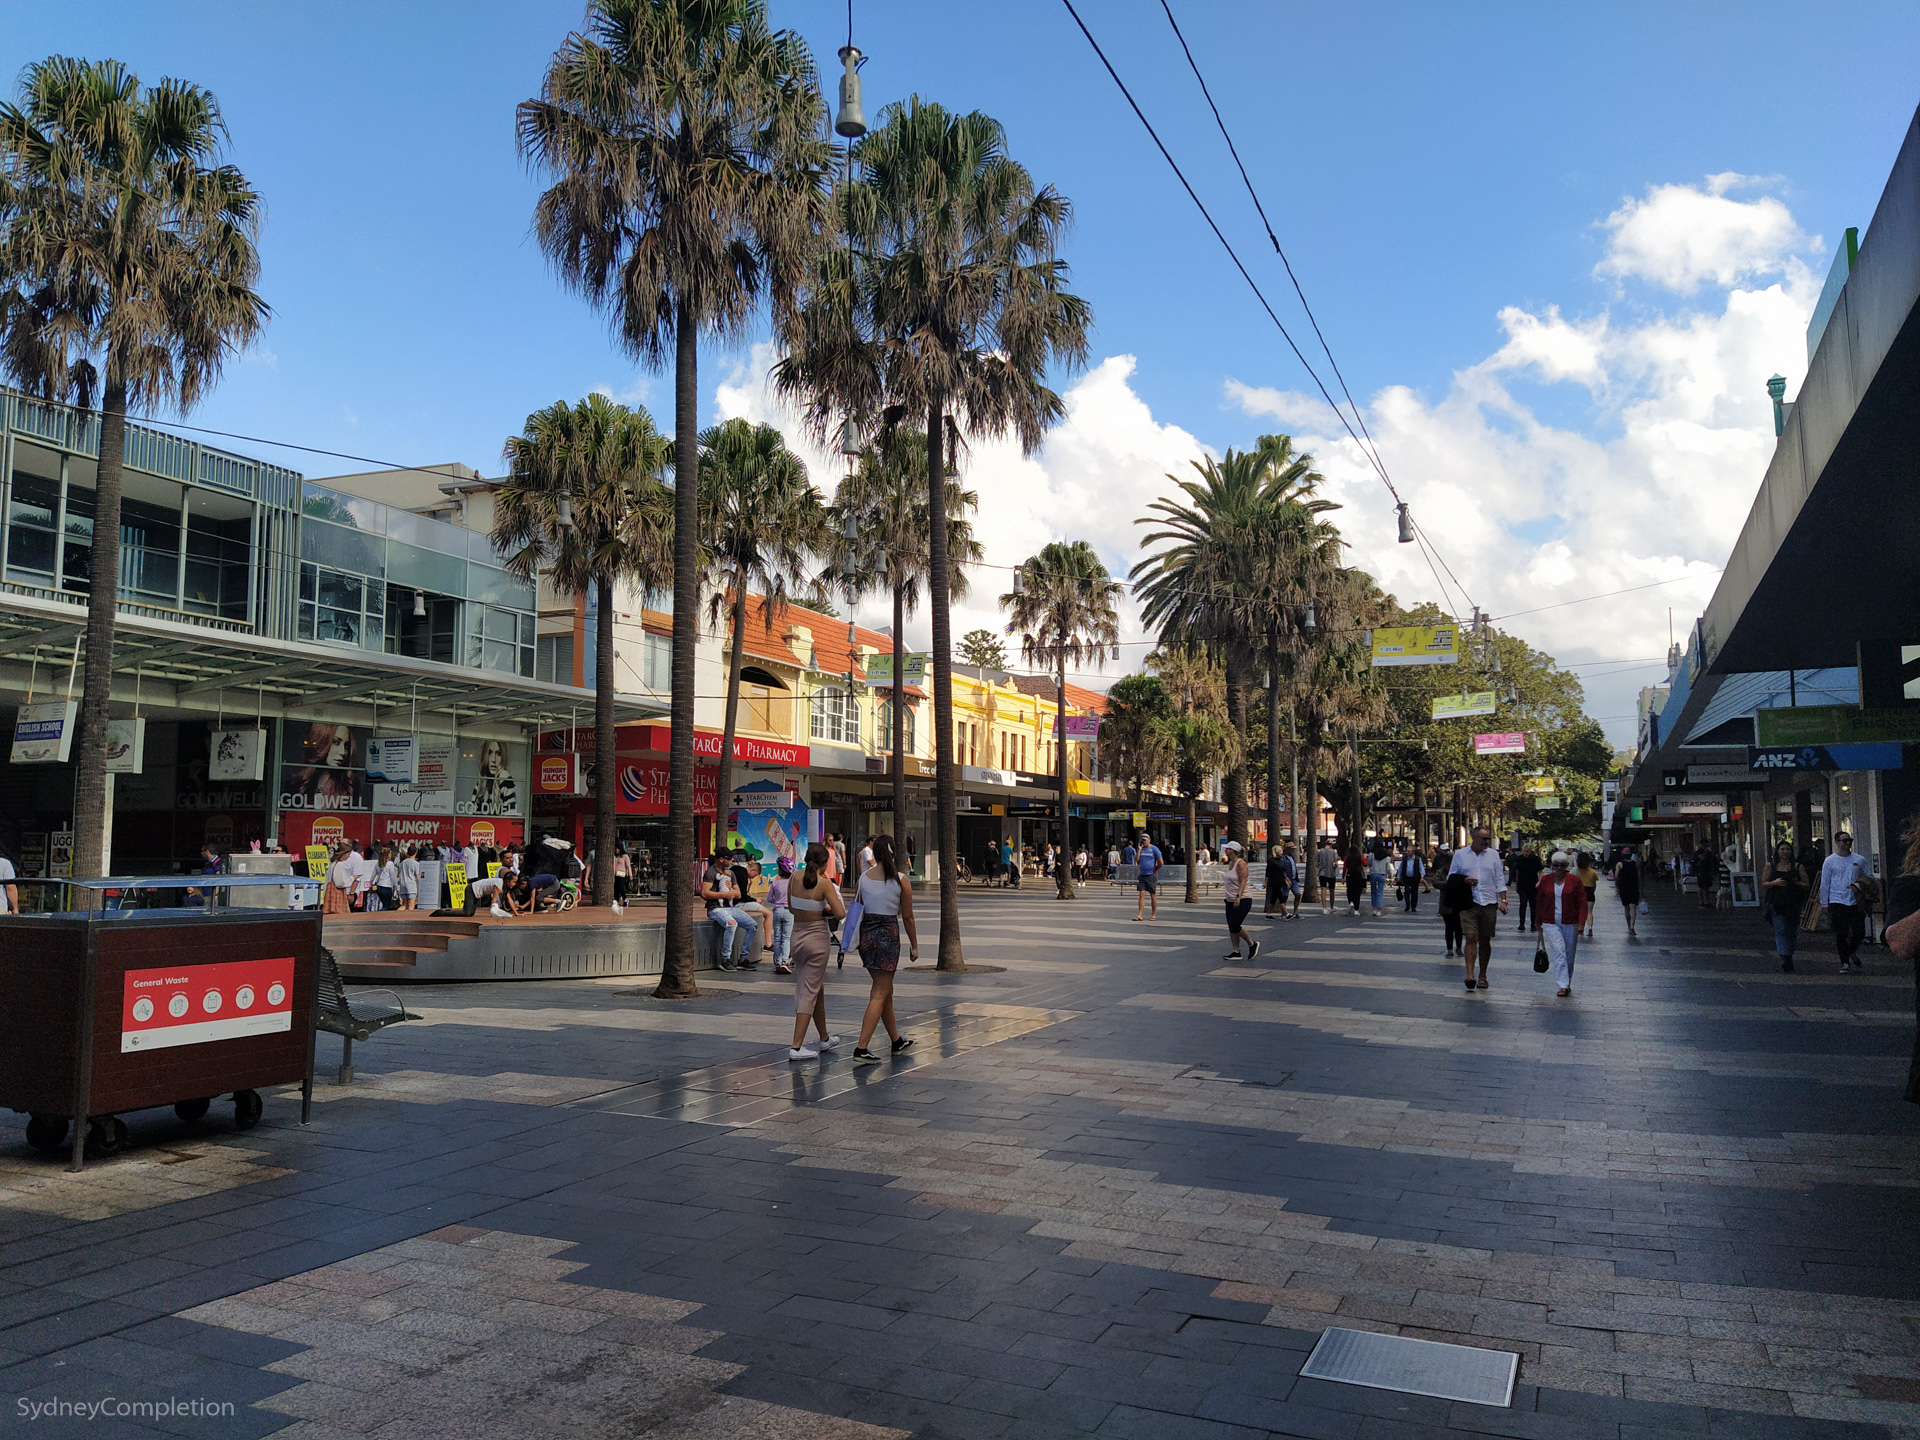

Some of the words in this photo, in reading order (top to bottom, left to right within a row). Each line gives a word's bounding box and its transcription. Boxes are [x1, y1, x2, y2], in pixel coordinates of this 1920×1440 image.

[41, 721, 62, 732] SCHOOL
[747, 742, 798, 763] PHARMACY
[1752, 753, 1796, 768] ANZ
[176, 791, 262, 809] GOLDWELL
[279, 792, 369, 810] GOLDWELL
[1680, 800, 1724, 808] TEASPOON
[455, 800, 523, 816] GOLDWELL
[313, 827, 342, 835] HUNGRY
[387, 819, 440, 835] HUNGRY
[310, 862, 328, 878] SALE
[449, 872, 467, 885] SALE
[133, 978, 164, 989] General
[165, 976, 190, 986] Waste
